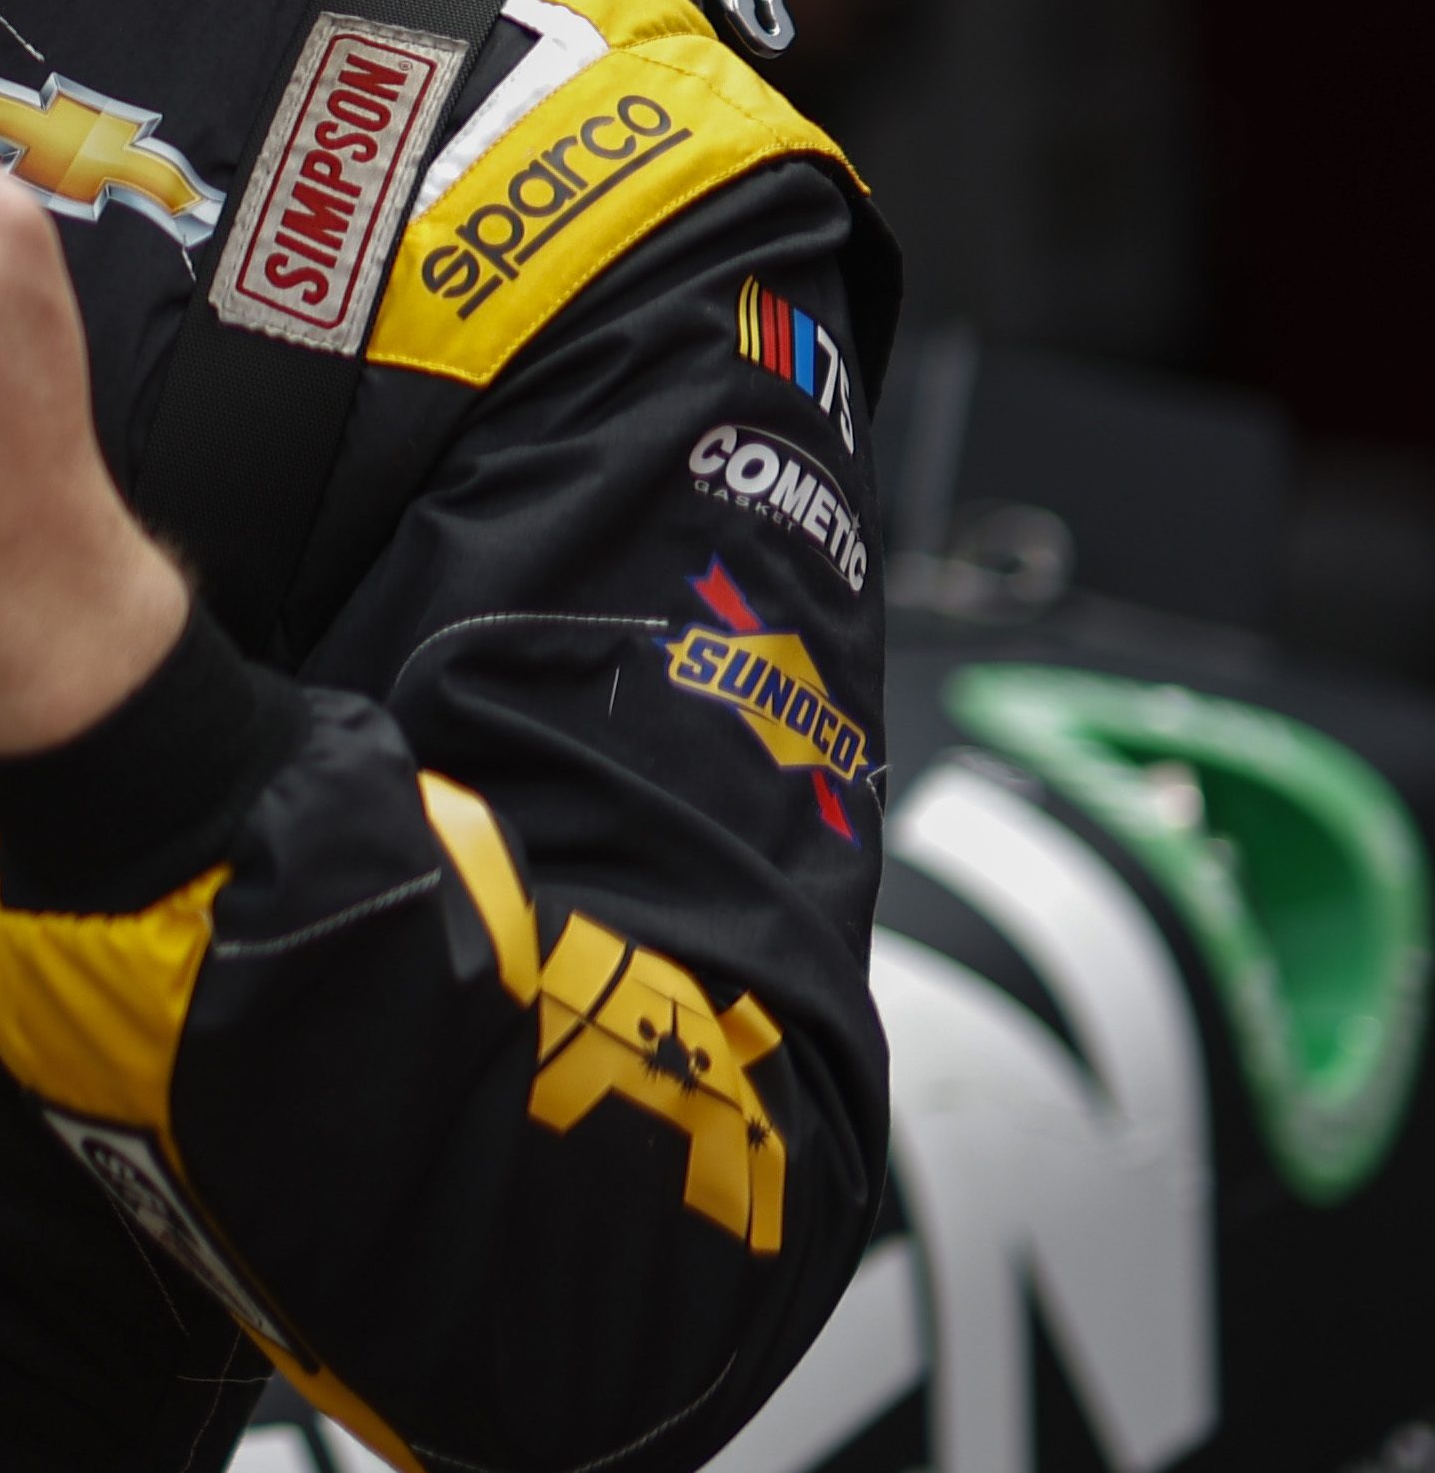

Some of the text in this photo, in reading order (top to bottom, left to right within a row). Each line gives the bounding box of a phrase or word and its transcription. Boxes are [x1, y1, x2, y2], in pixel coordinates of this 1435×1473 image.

[263, 52, 411, 306] SIMPSON
[421, 94, 694, 321] sparco
[688, 425, 867, 593] COMETIC
[676, 636, 862, 773] SUNOCO
